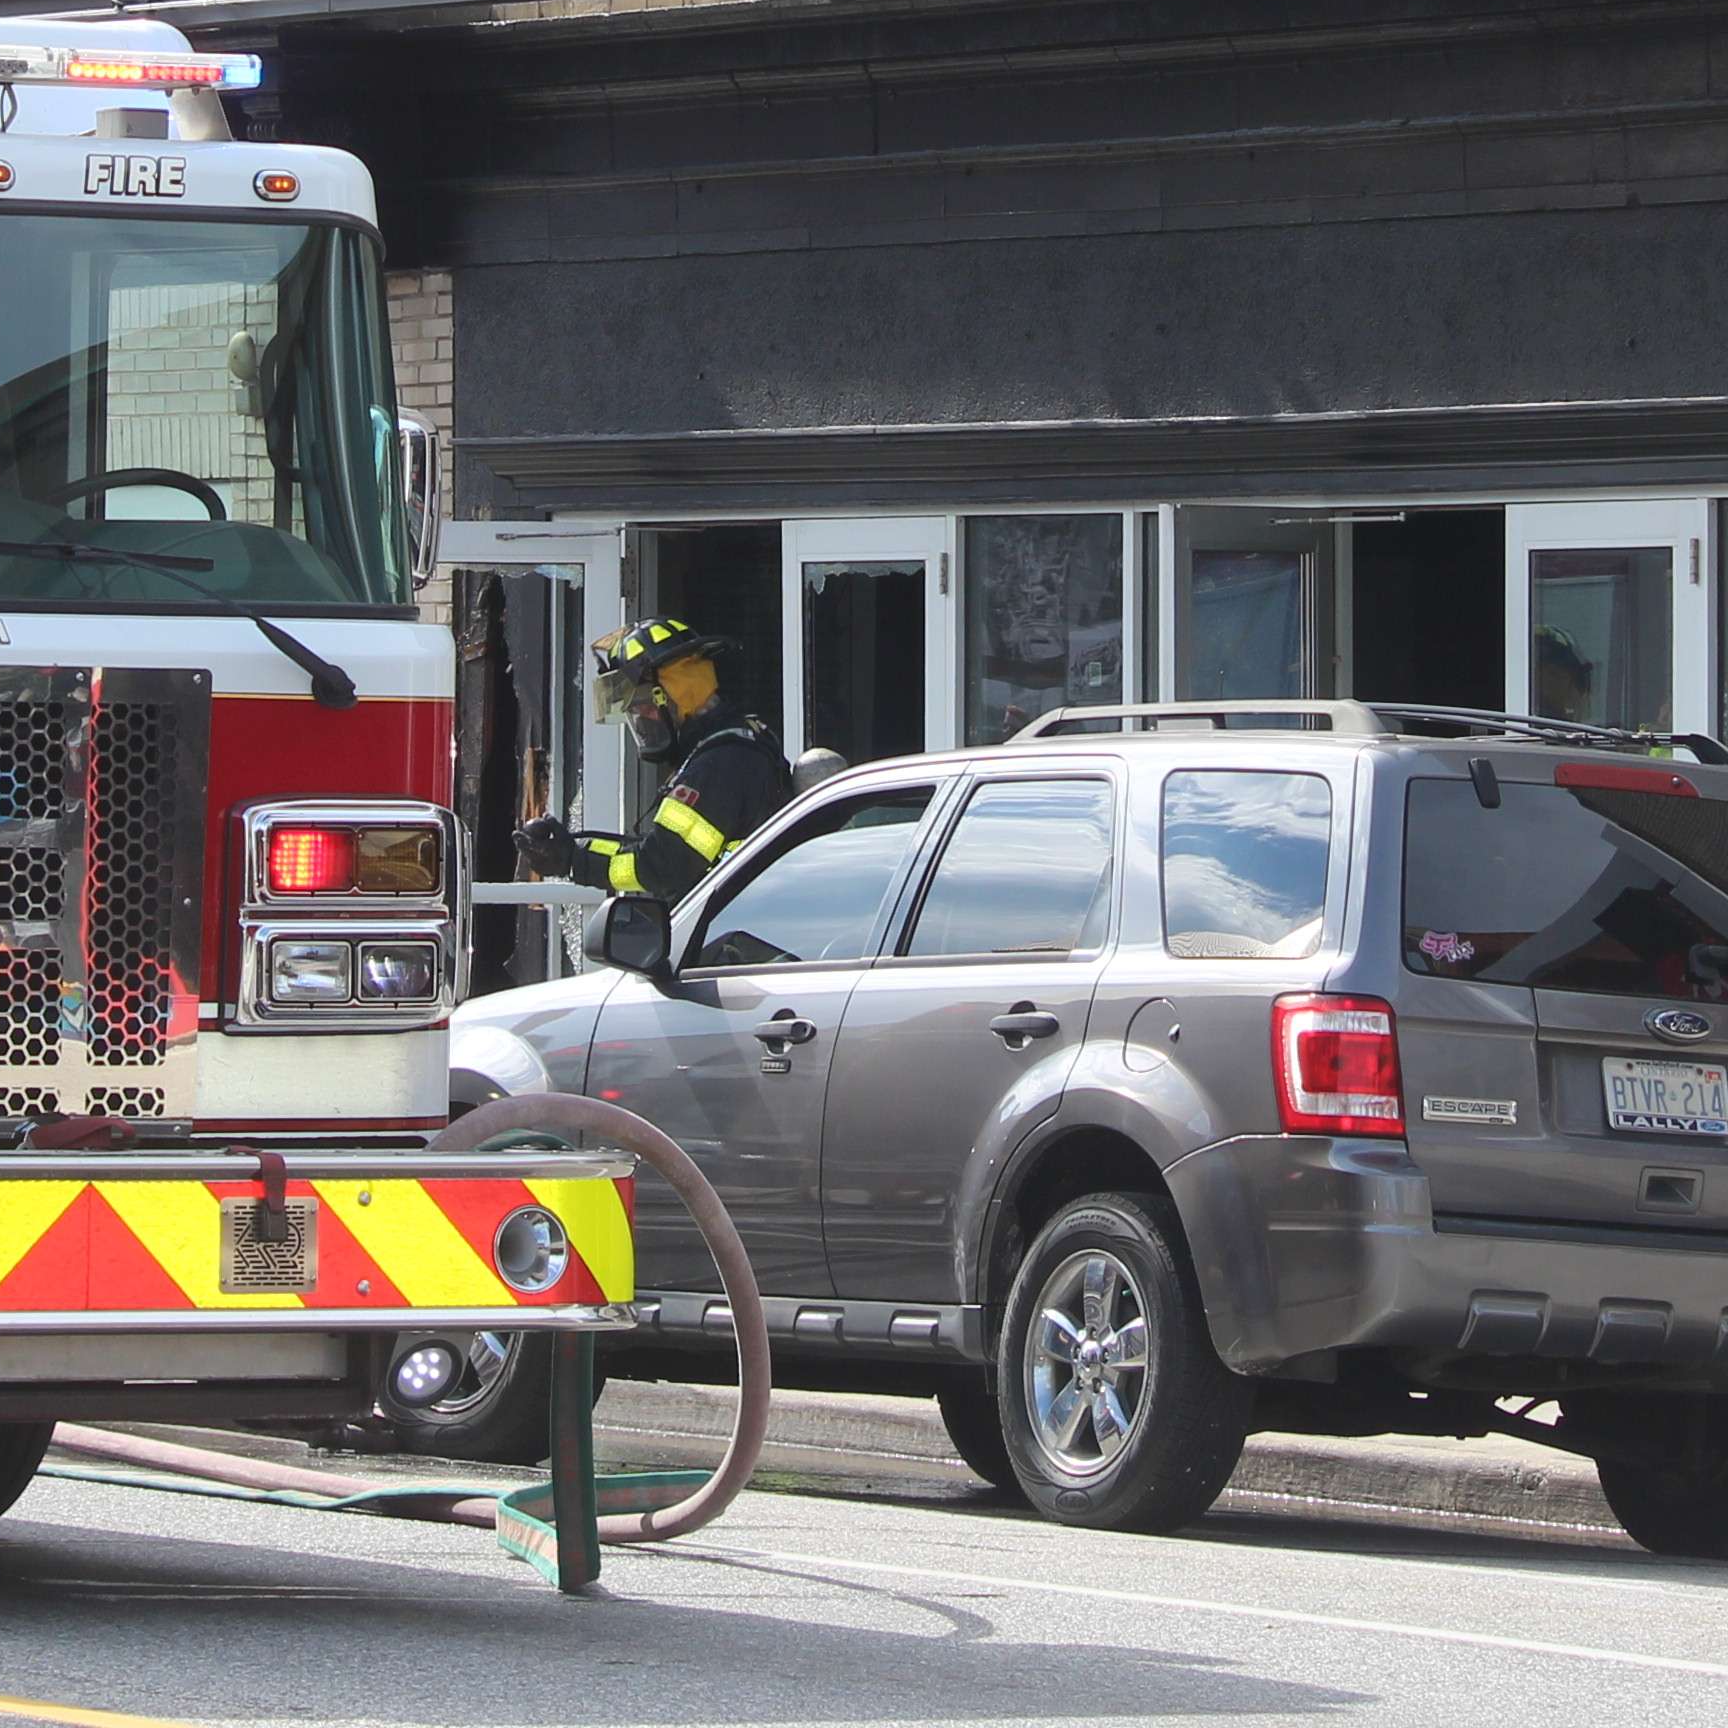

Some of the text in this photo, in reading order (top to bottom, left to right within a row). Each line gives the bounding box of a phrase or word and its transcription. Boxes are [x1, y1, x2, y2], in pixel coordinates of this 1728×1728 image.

[84, 154, 186, 197] FIRE
[1670, 1015, 1702, 1032] Ford
[1613, 1076, 1725, 1118] BTVR 214
[1431, 1100, 1510, 1115] ESCAPE
[1617, 1114, 1695, 1130] LALLY
